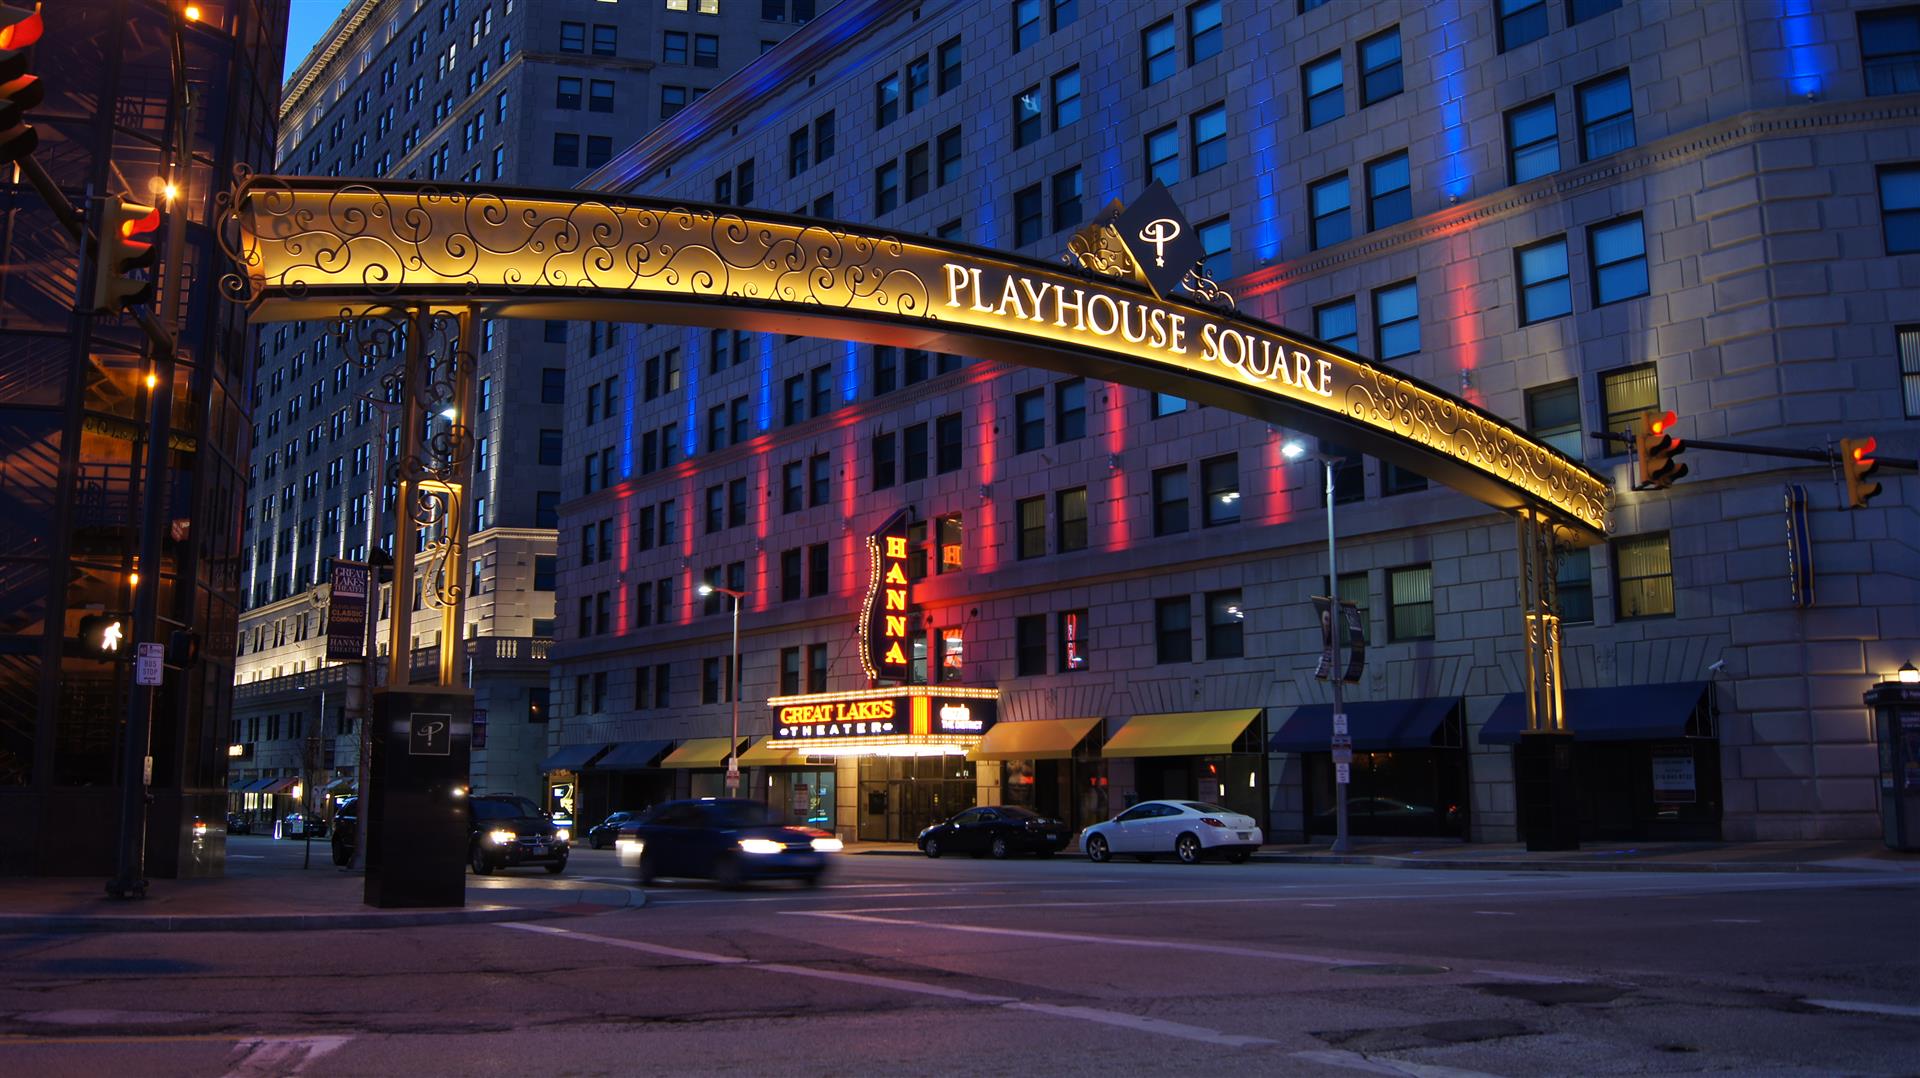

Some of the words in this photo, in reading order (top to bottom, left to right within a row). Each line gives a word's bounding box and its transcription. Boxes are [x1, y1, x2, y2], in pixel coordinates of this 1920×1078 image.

[943, 262, 1187, 355] PLAYHOUSE
[1201, 323, 1332, 397] SQUARE
[334, 567, 365, 578] GREAT
[334, 576, 365, 587] LAKES
[885, 535, 907, 664] HANNA
[331, 609, 364, 618] CLASSIC
[331, 616, 363, 624] COMPANY
[330, 638, 361, 647] HANNA
[144, 660, 157, 668] BUS
[143, 668, 158, 676] STOP
[780, 704, 833, 724] GREAT
[836, 700, 895, 720] LAKES
[789, 721, 882, 737] THEATER
